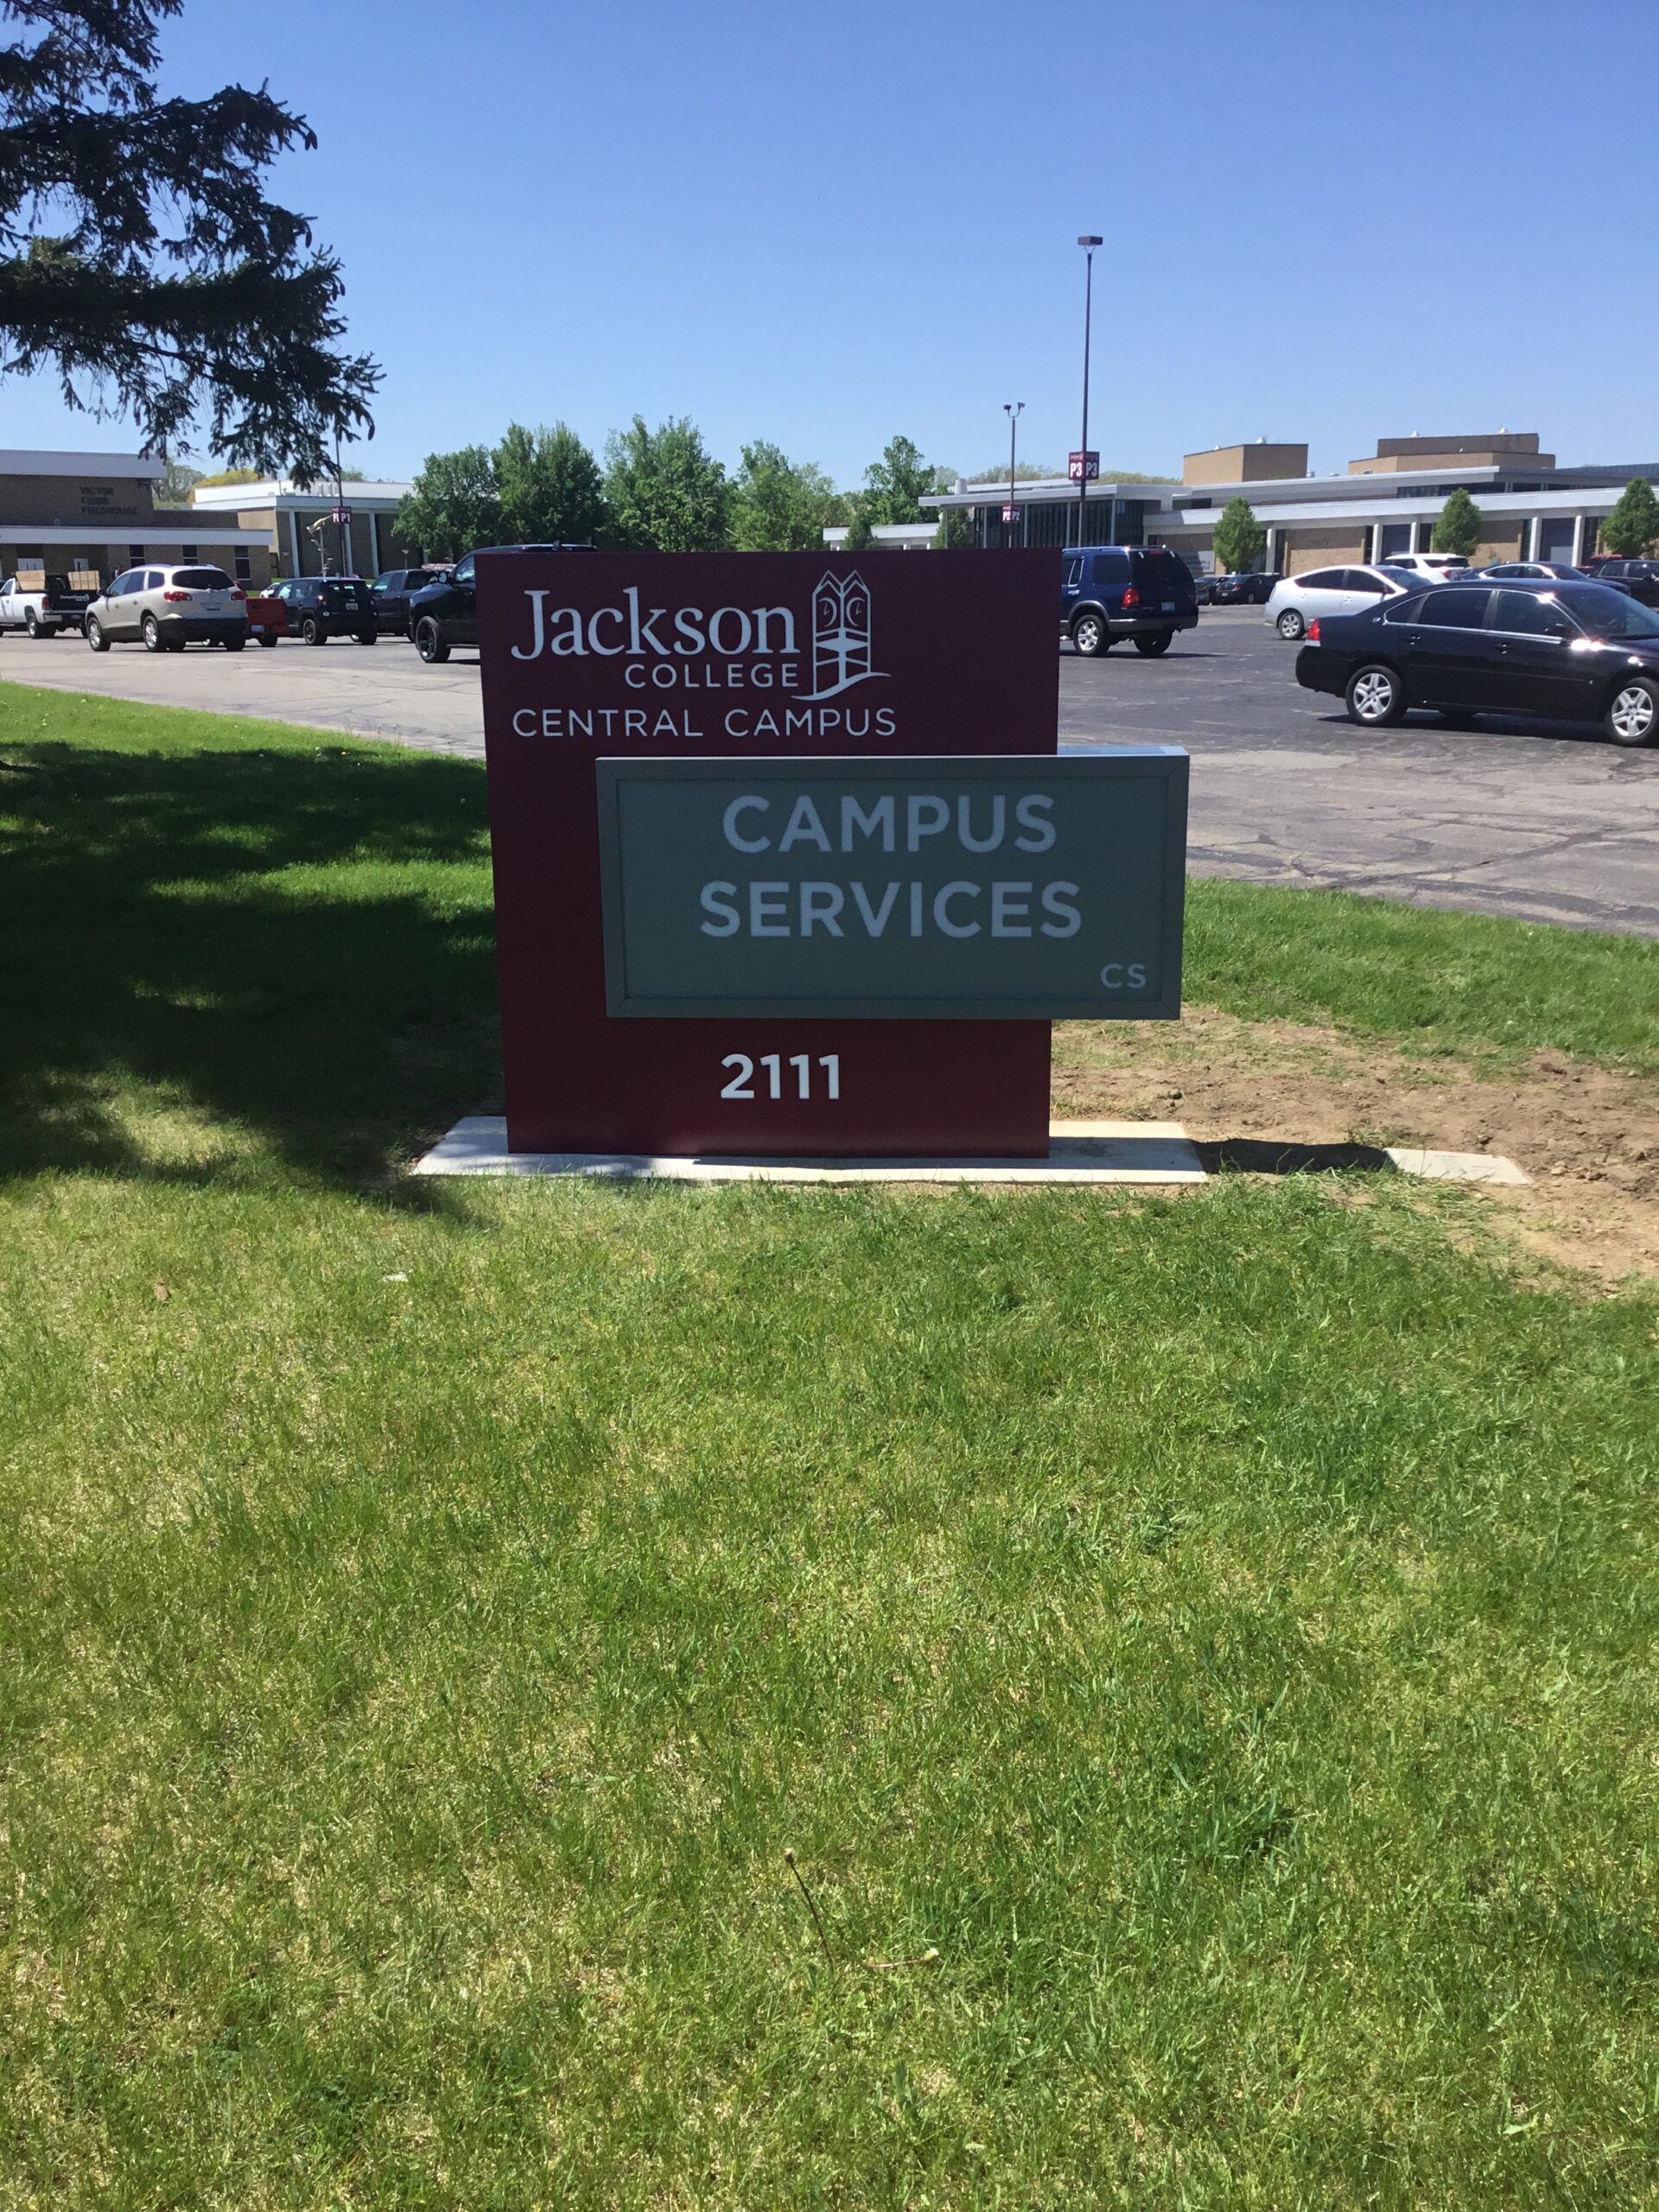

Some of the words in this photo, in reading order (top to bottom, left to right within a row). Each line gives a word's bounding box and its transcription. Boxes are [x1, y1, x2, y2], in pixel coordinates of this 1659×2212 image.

[1070, 461, 1083, 477] P3
[1085, 461, 1097, 477] P3
[340, 512, 351, 523] P1
[1002, 511, 1011, 521] P2
[1012, 511, 1020, 520] P2
[512, 587, 799, 659] Jackson
[625, 663, 798, 689] COLLEGE
[512, 709, 703, 737] CENTRAL
[724, 709, 897, 737] CAMPUS
[723, 794, 1057, 854] CAMPUS
[701, 880, 1083, 938] SERVICES
[1100, 963, 1147, 988] CS
[721, 1053, 840, 1100] 2111
